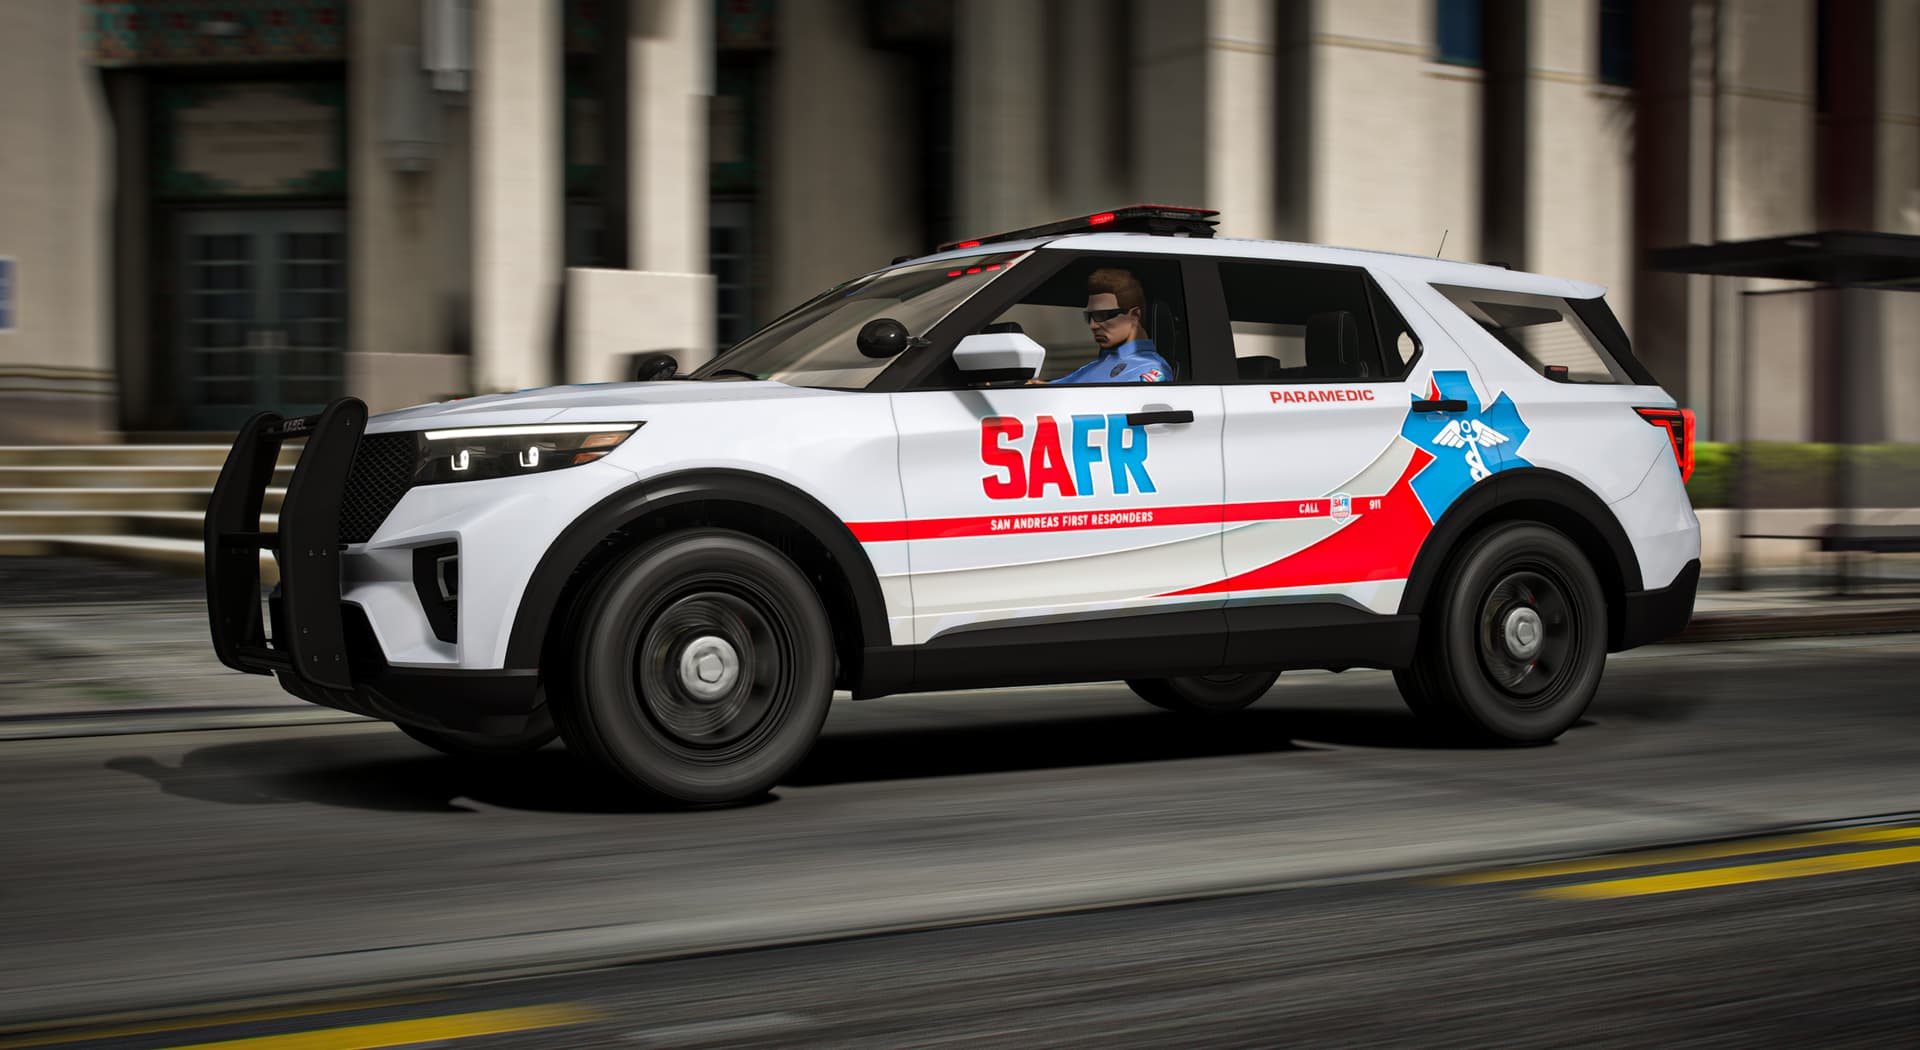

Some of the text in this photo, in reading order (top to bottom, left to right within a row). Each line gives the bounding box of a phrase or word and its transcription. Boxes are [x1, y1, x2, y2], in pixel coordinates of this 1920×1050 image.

[1270, 390, 1374, 403] PARAMEDIC
[981, 414, 1157, 500] SAFR
[1299, 503, 1319, 513] CALL
[1369, 499, 1381, 510] 911
[991, 511, 1153, 531] SAN ANDREAS FIRST RESPONDERS
